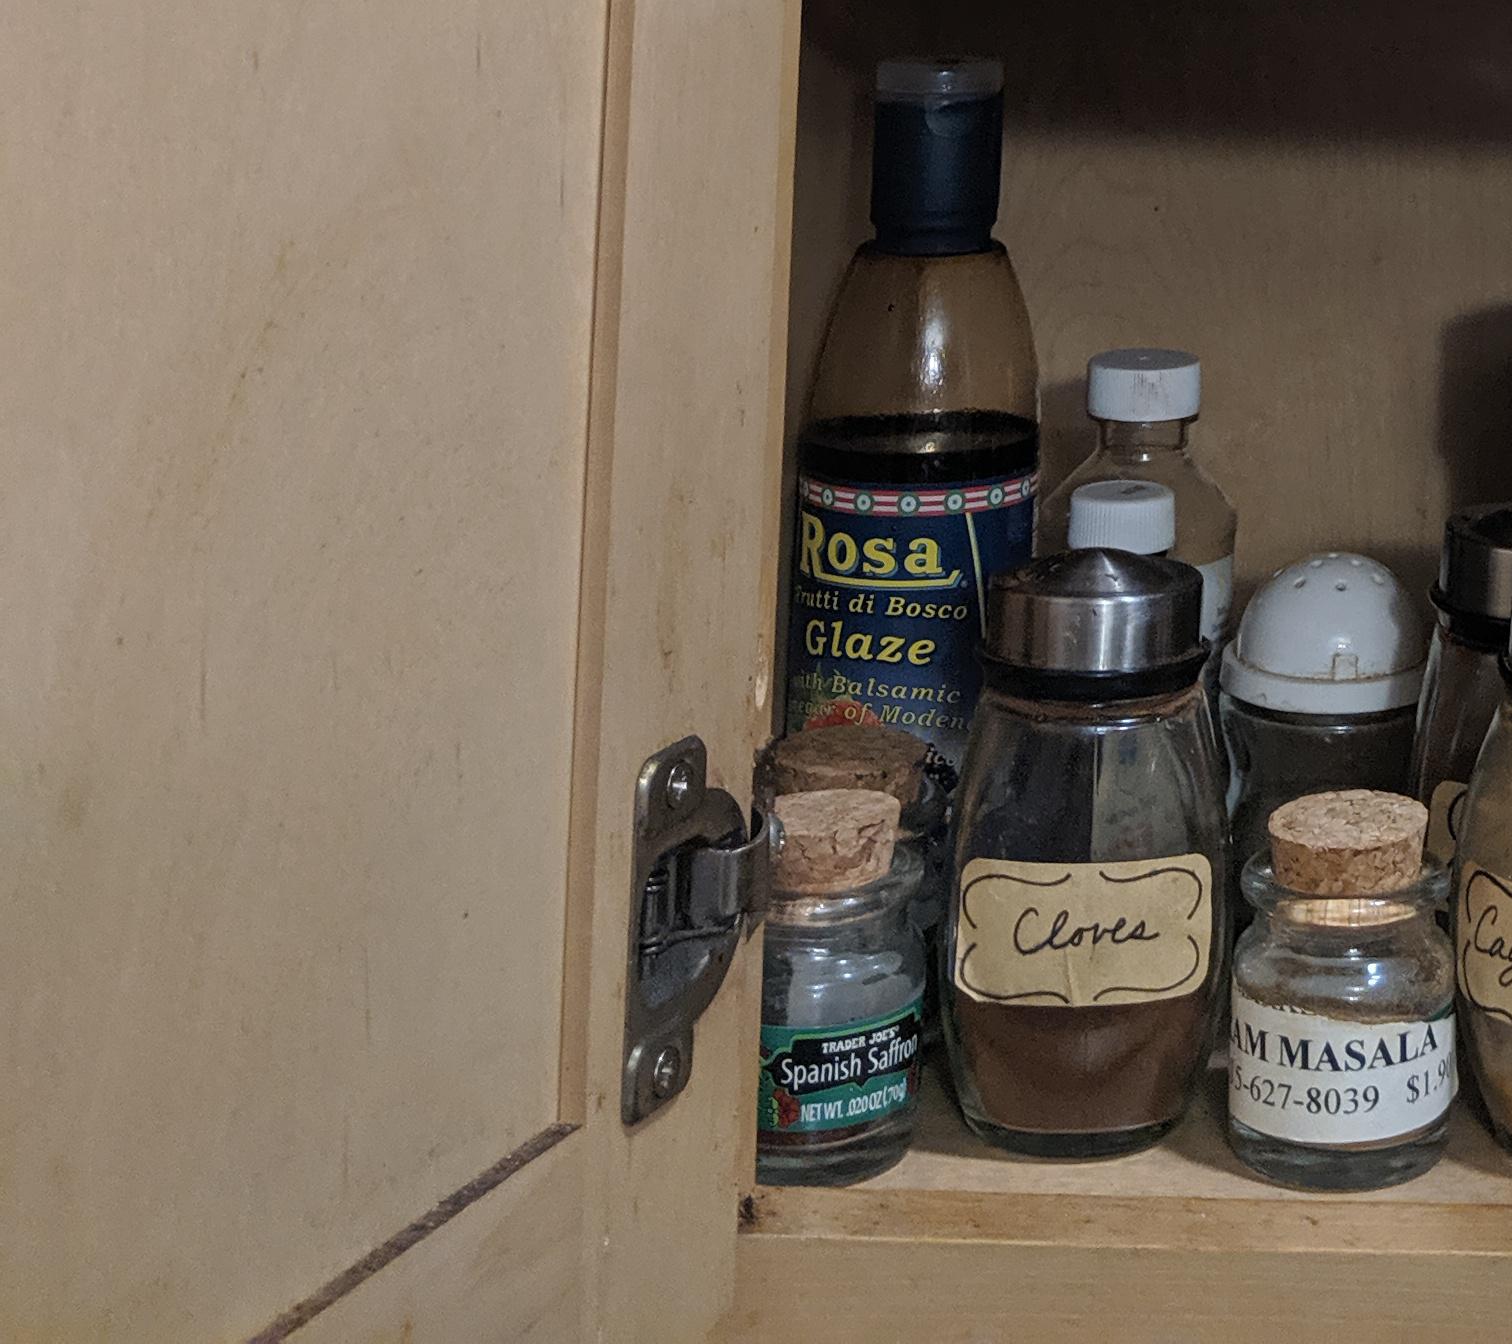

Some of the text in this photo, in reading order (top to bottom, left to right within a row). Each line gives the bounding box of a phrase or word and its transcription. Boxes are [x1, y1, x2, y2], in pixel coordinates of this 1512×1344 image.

[801, 510, 946, 578] Rosa
[848, 593, 876, 614] di
[885, 596, 968, 620] Bosco
[805, 619, 936, 666] Glaze
[831, 673, 961, 704] Balsamic
[844, 703, 873, 726] of
[1013, 906, 1160, 956] Cloves
[781, 1034, 918, 1091] Spanish Saffron
[822, 1027, 896, 1054] TRADER JOE'S
[1278, 1023, 1438, 1072] MASALA
[801, 1102, 822, 1122] NET
[869, 1091, 882, 1110] OZ
[1230, 1065, 1380, 1115] 5-627-8039
